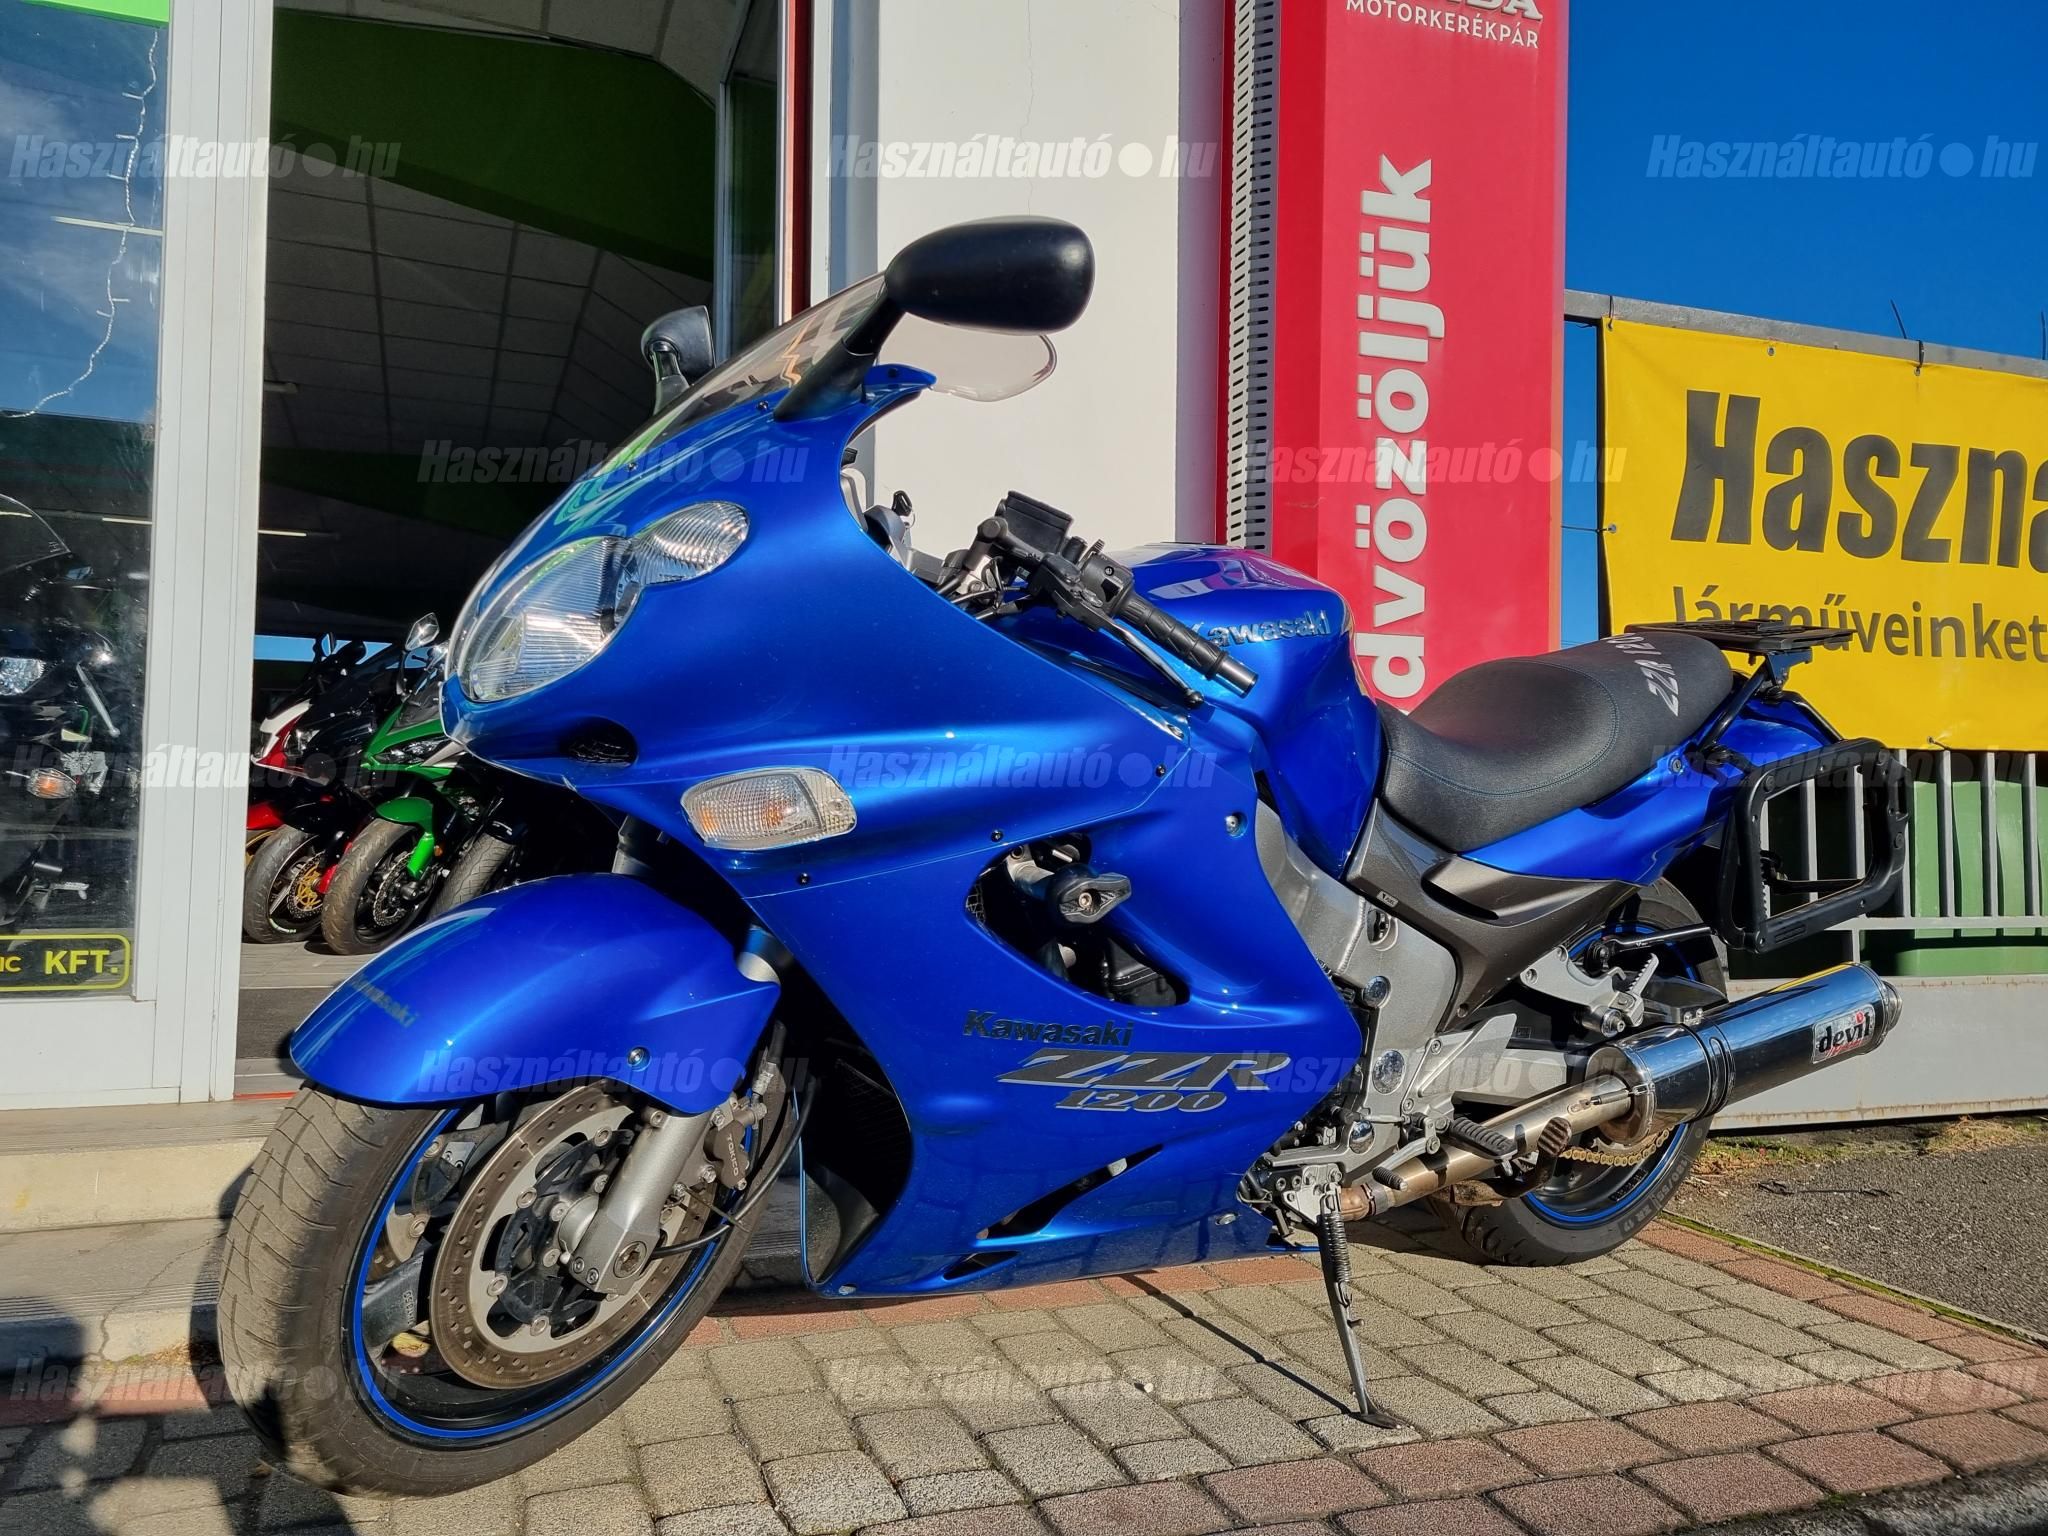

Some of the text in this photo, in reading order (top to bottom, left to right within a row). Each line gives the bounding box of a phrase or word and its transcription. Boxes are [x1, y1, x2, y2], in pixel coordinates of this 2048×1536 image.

[1346, 0, 1539, 49] MOTORKERÉKPÁR
[1356, 153, 1445, 714] dvözöljük
[1670, 388, 2048, 573] Haszn
[44, 949, 119, 975] KFT.
[963, 1010, 1134, 1047] Kawasaki
[1819, 1011, 1871, 1053] devil
[995, 1048, 1291, 1091] ZZR
[1055, 1090, 1227, 1113] 1200
[727, 1132, 739, 1177] TOKICO
